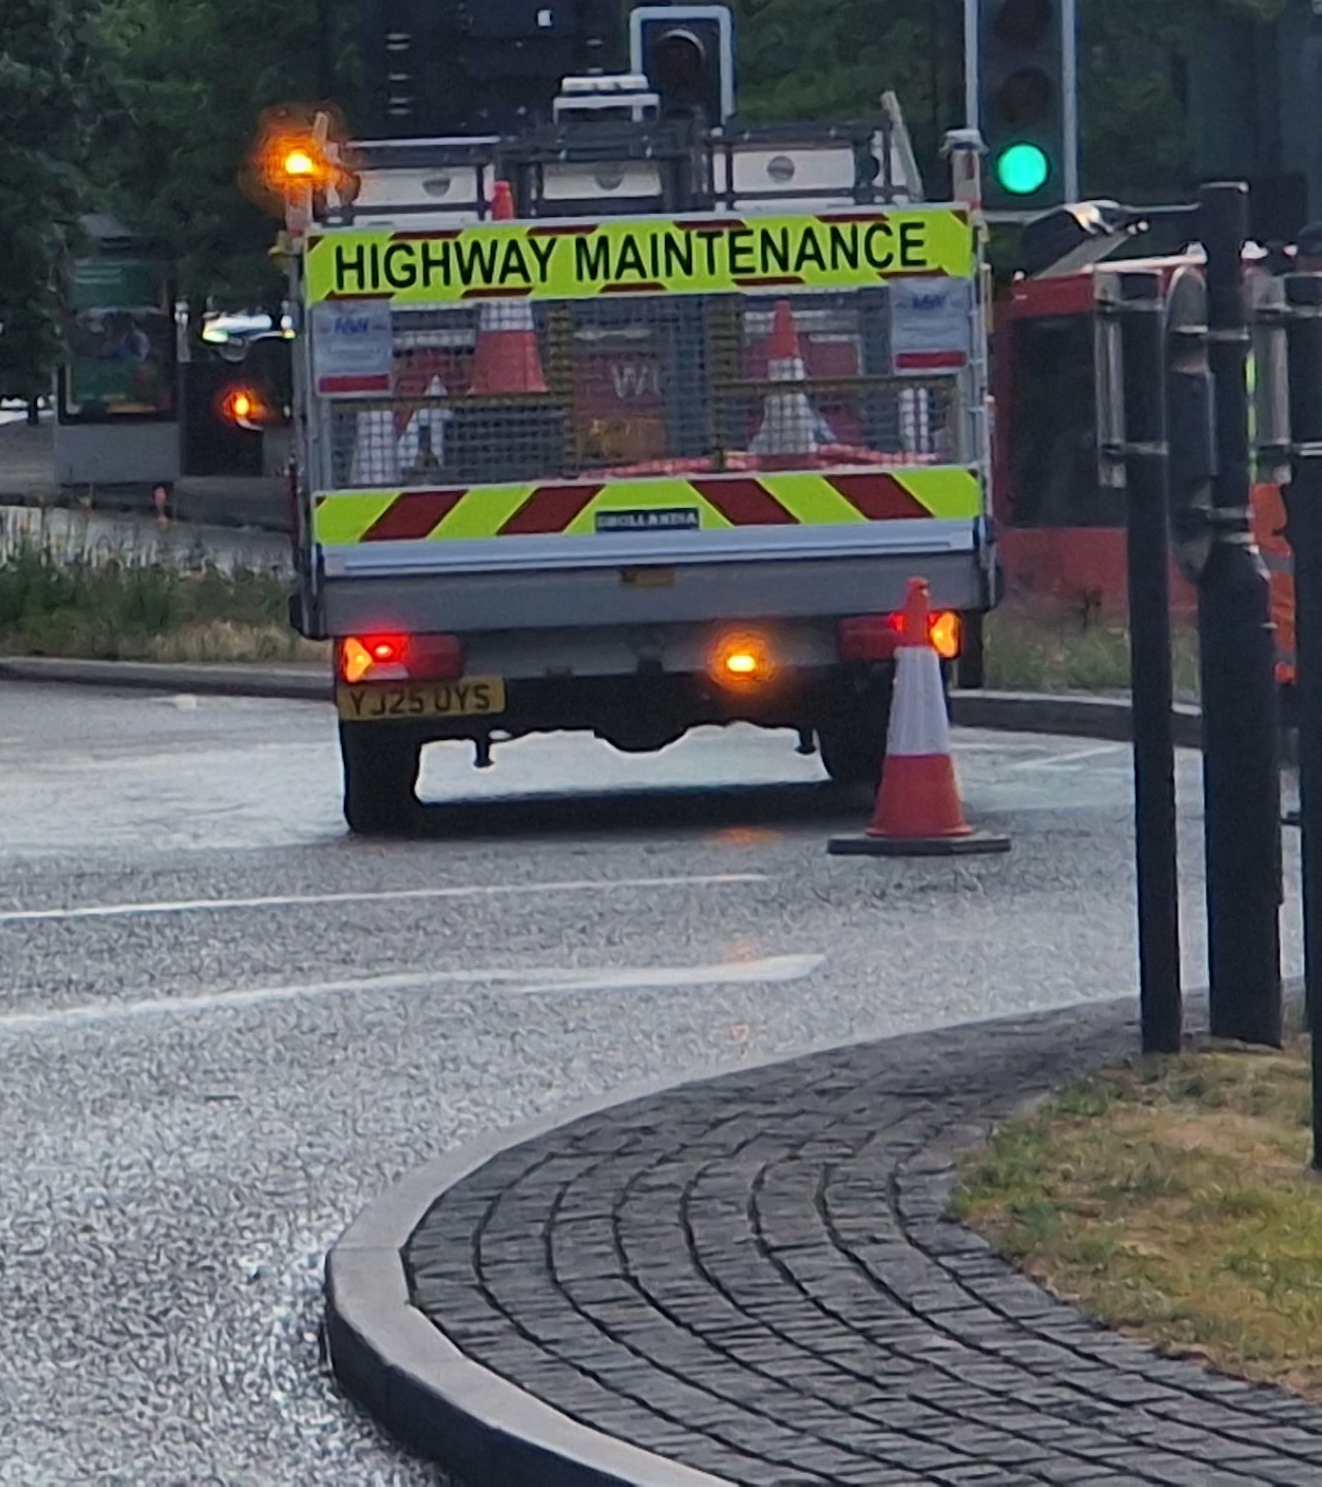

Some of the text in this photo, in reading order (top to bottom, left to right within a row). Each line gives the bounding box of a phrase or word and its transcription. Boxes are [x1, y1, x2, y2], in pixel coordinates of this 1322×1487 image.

[335, 221, 928, 290] HIGHWAY MAINTENANCE
[434, 684, 490, 712] UYS
